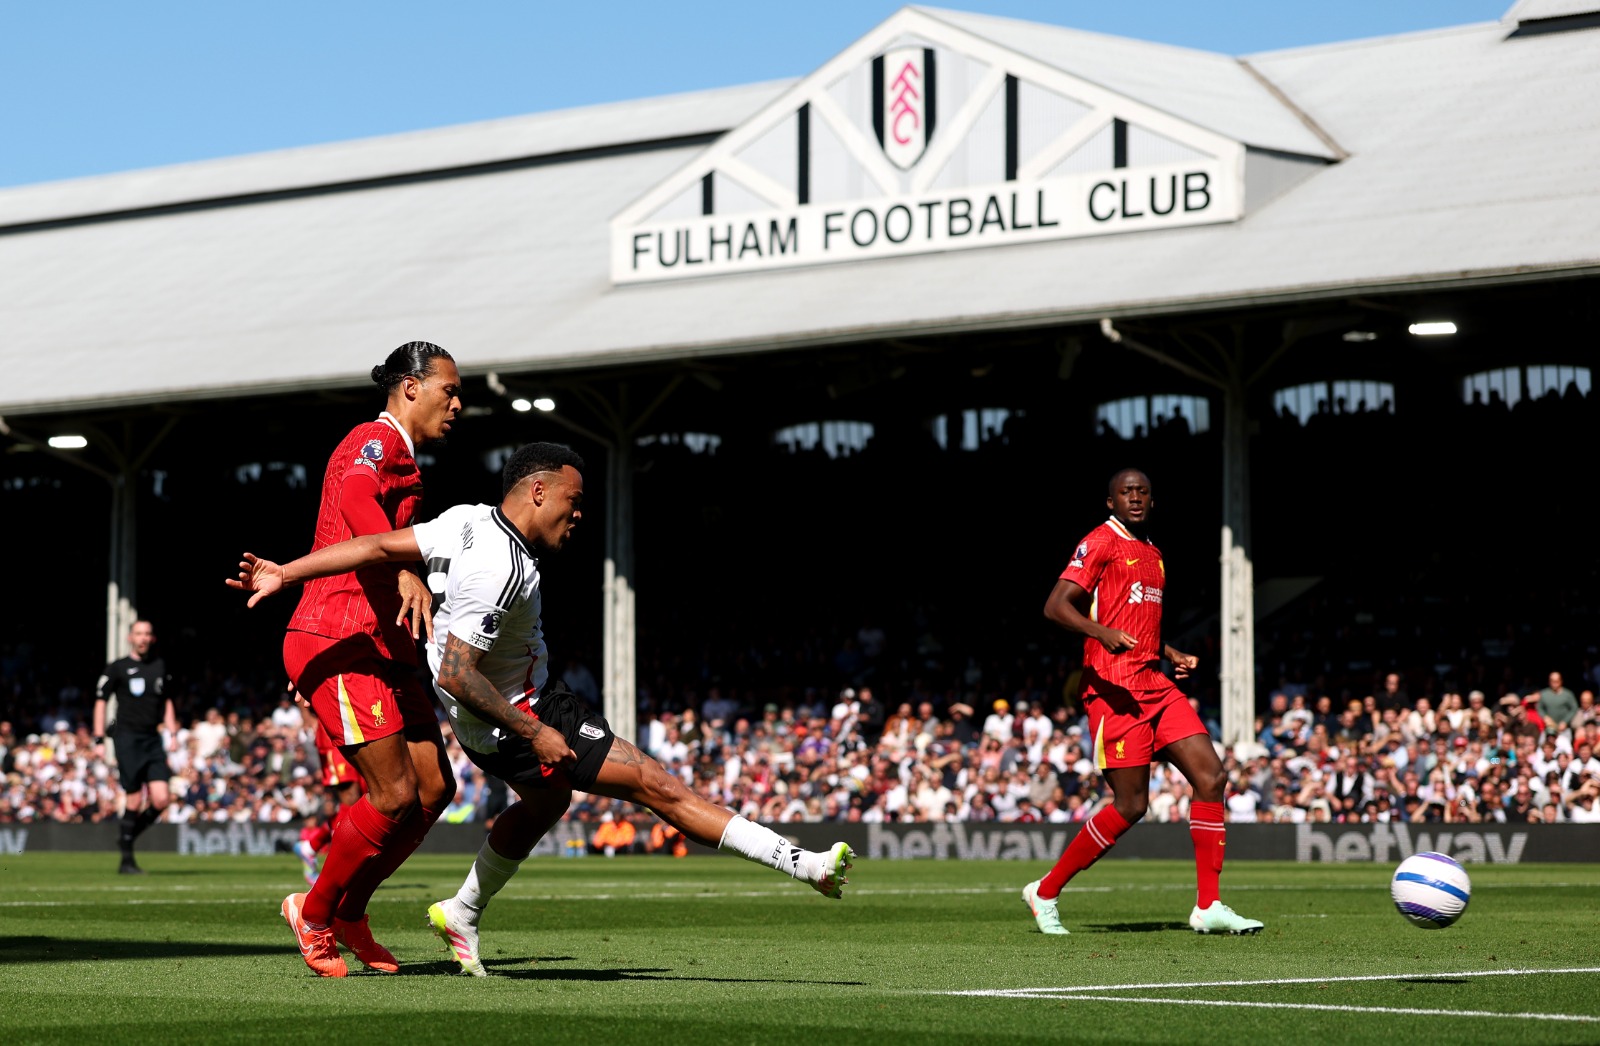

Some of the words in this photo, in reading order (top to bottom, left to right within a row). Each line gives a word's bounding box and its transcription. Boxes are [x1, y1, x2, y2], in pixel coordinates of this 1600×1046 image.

[890, 61, 920, 146] FFC
[632, 217, 798, 270] FULHAM
[823, 189, 1060, 250] FOOTBALL
[1088, 172, 1211, 222] CLUB
[771, 838, 786, 861] FFC
